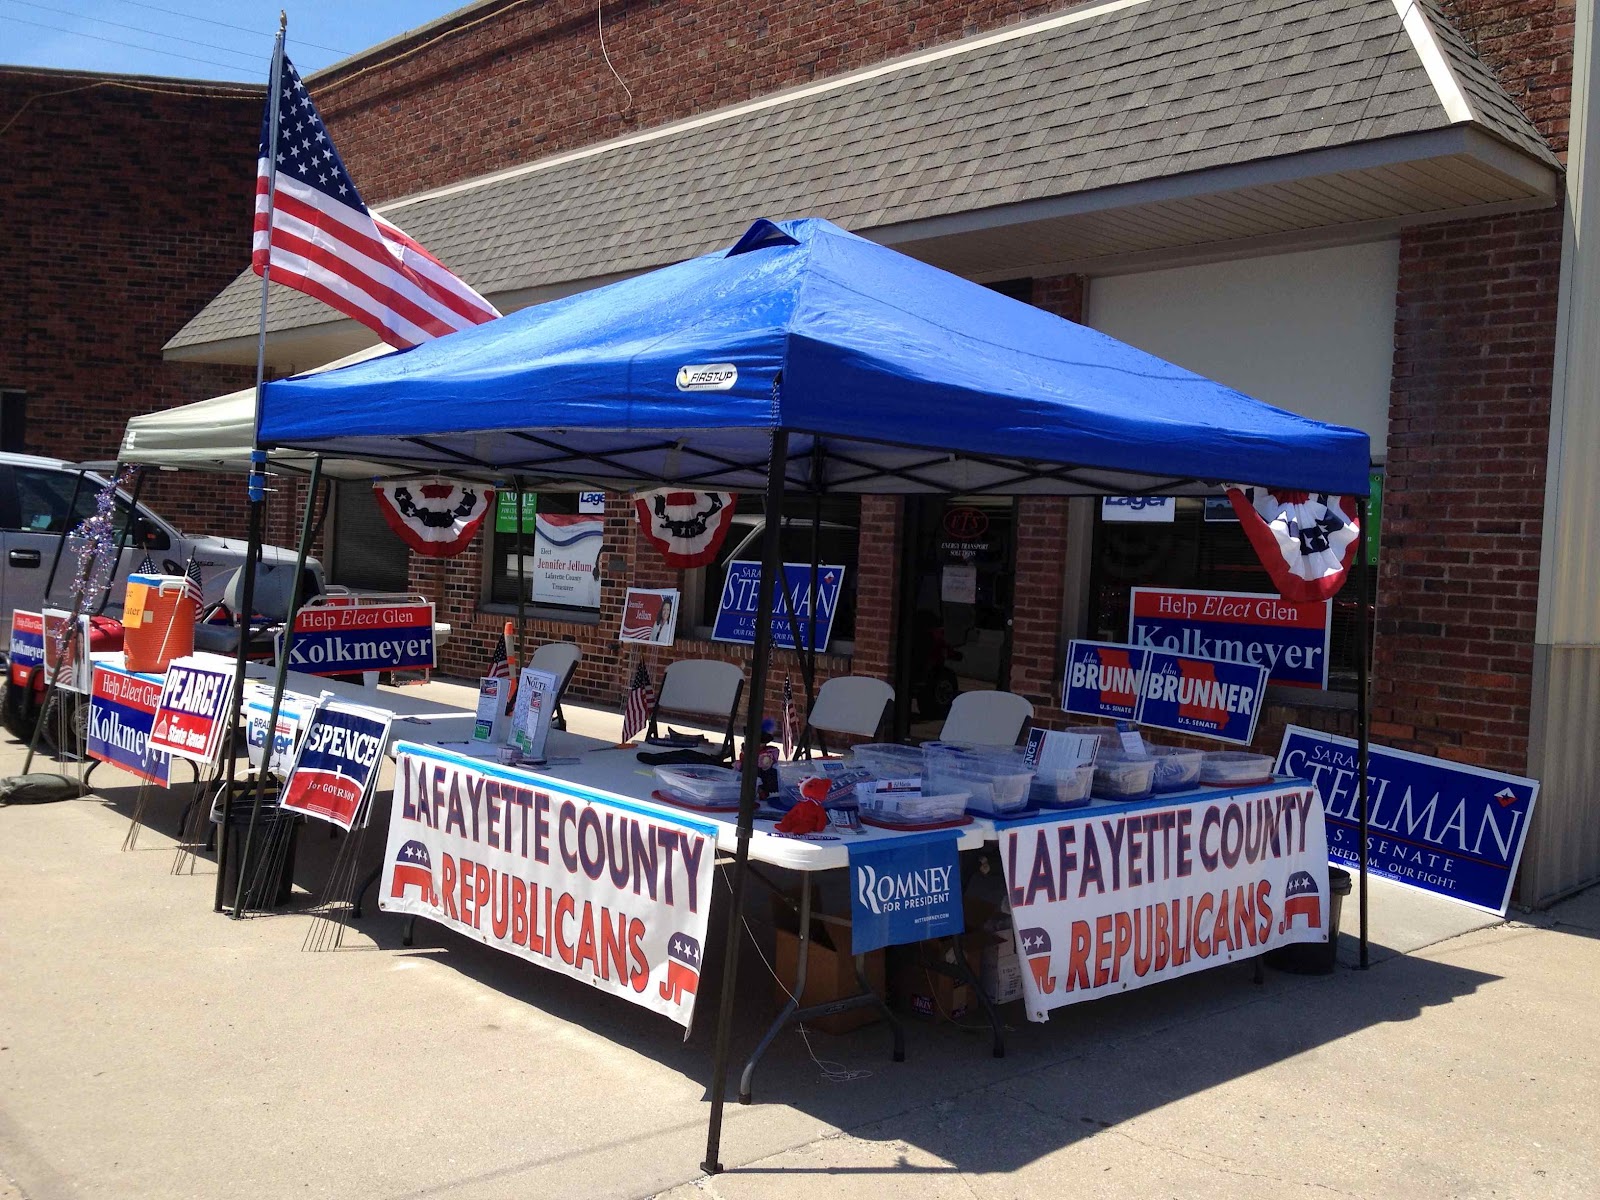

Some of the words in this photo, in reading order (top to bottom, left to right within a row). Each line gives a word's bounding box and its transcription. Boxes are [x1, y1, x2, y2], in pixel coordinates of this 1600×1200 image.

[580, 492, 605, 505] Lage
[540, 547, 552, 555] Elect
[537, 558, 566, 571] Jennifer
[567, 559, 592, 573] Jellum
[545, 572, 565, 581] Lafayette
[566, 573, 582, 583] County
[741, 567, 761, 578] SARA
[552, 582, 574, 592] Treasurer
[301, 612, 336, 629] Help
[341, 610, 379, 626] Elect
[382, 608, 414, 623] Glen
[1159, 595, 1197, 619] Help
[1202, 596, 1251, 618] Elect
[1255, 601, 1298, 621] Glen
[11, 637, 44, 662] Kolkmeyer
[283, 637, 432, 665] Kolkmeyer
[1080, 651, 1098, 665] John
[1135, 624, 1322, 674] Kolkmeyer
[1071, 661, 1141, 696] BRUNN
[1160, 661, 1177, 676] John
[102, 673, 120, 700] Help
[120, 677, 143, 704] Elect
[162, 668, 222, 717] PEARCE
[525, 675, 548, 691] NOLTE
[1147, 672, 1254, 716] BRUNNER
[1112, 705, 1132, 714] SENATE
[167, 724, 187, 745] State
[1177, 717, 1191, 725] U.S.
[1192, 718, 1218, 730] SENATE
[307, 722, 380, 767] SPENCE
[307, 780, 321, 790] for
[322, 783, 355, 802] GOVERNOR
[402, 756, 551, 865] LAFAYETTE
[558, 800, 705, 914] COUNTY
[1008, 808, 1193, 907] LAFAYETTE
[1200, 790, 1314, 872] COUNTY
[1366, 837, 1454, 873] SENATE
[1388, 862, 1415, 878] OUR
[1417, 870, 1457, 890] FIGHT.
[858, 865, 953, 914] ROMNEY
[883, 901, 901, 913] FOR
[904, 892, 950, 910] PRESIDENT
[441, 851, 651, 994] REPUBLICANS
[1065, 879, 1273, 994] REPUBLICANS
